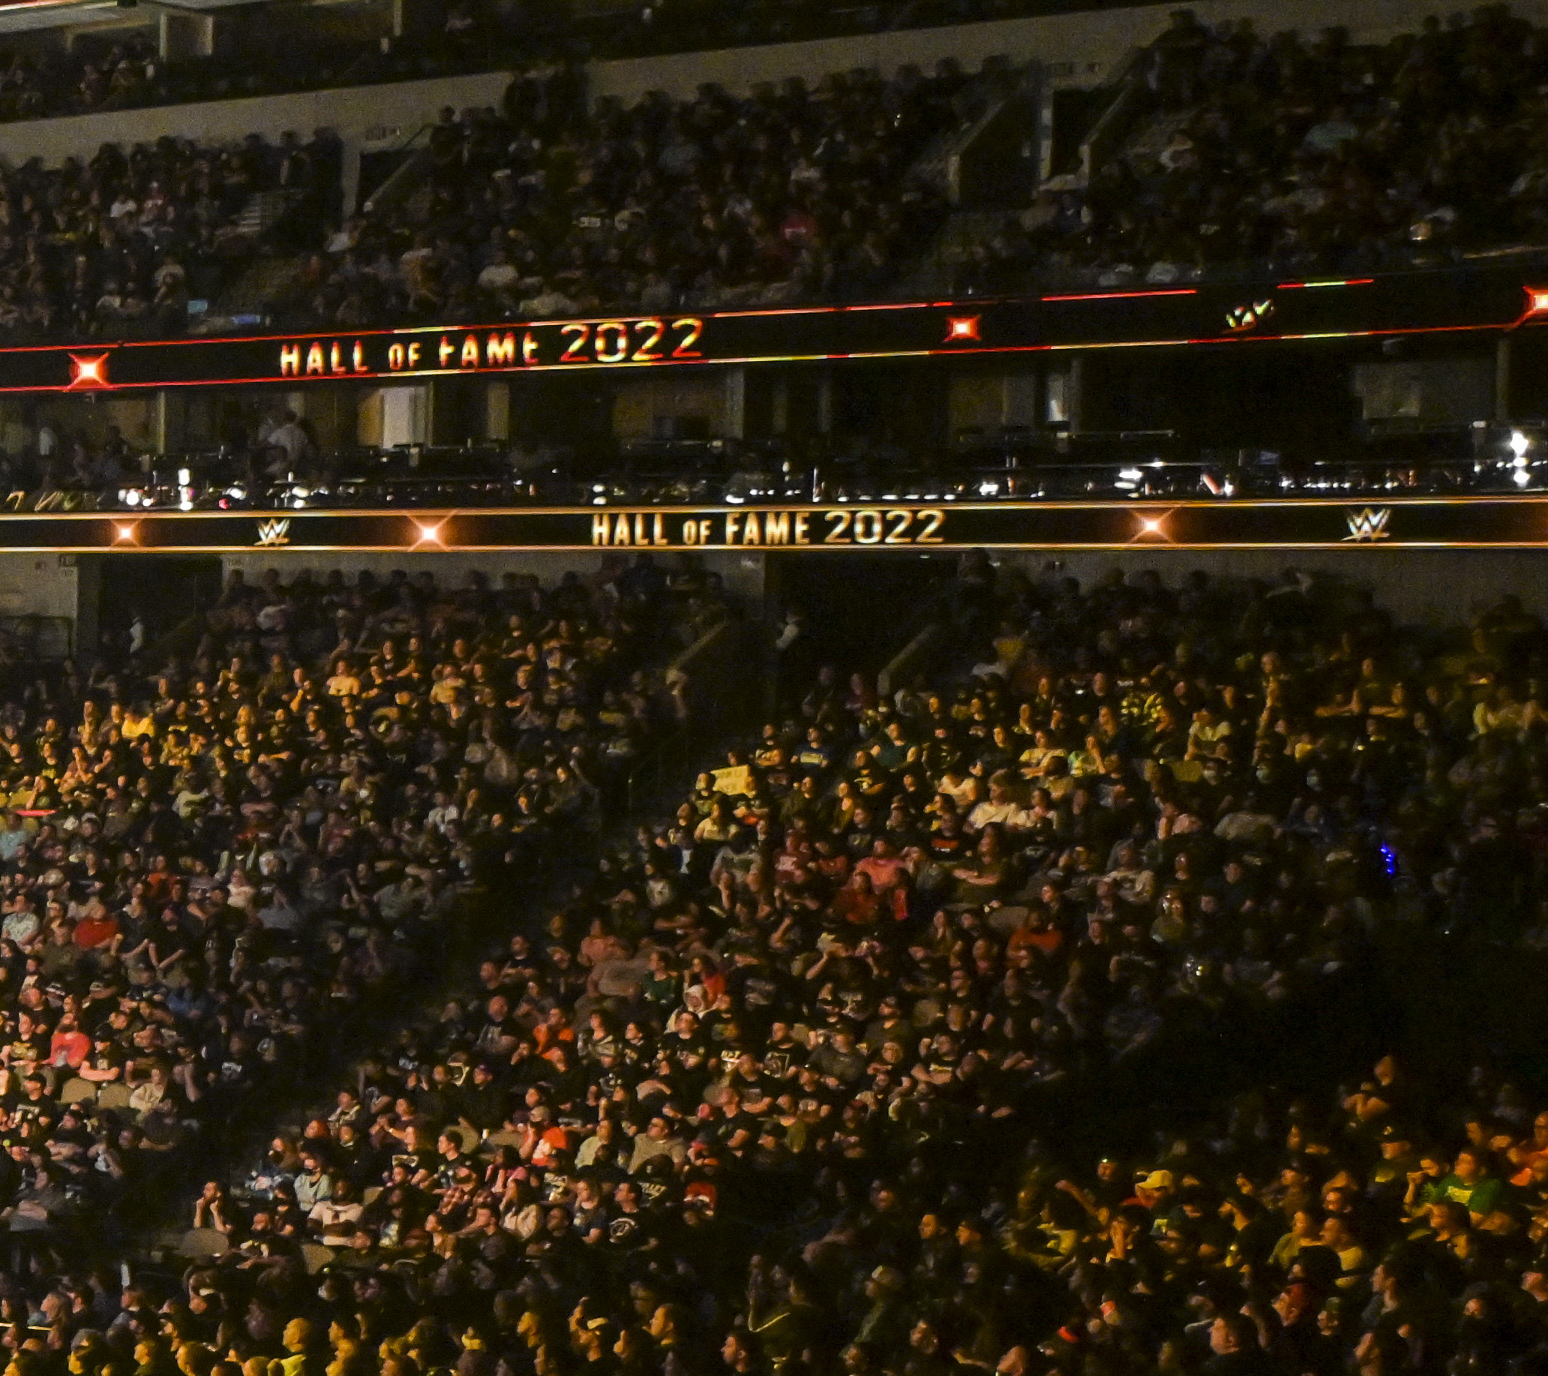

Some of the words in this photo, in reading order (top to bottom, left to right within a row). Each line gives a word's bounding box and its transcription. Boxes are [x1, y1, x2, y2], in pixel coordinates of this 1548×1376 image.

[279, 339, 369, 377] HALL
[388, 342, 421, 370] OF
[439, 331, 539, 367] FAME
[560, 317, 703, 363] 2022
[591, 513, 668, 545] HALL
[683, 520, 712, 545] OF
[725, 512, 810, 545] FAME
[824, 510, 946, 544] 2022
